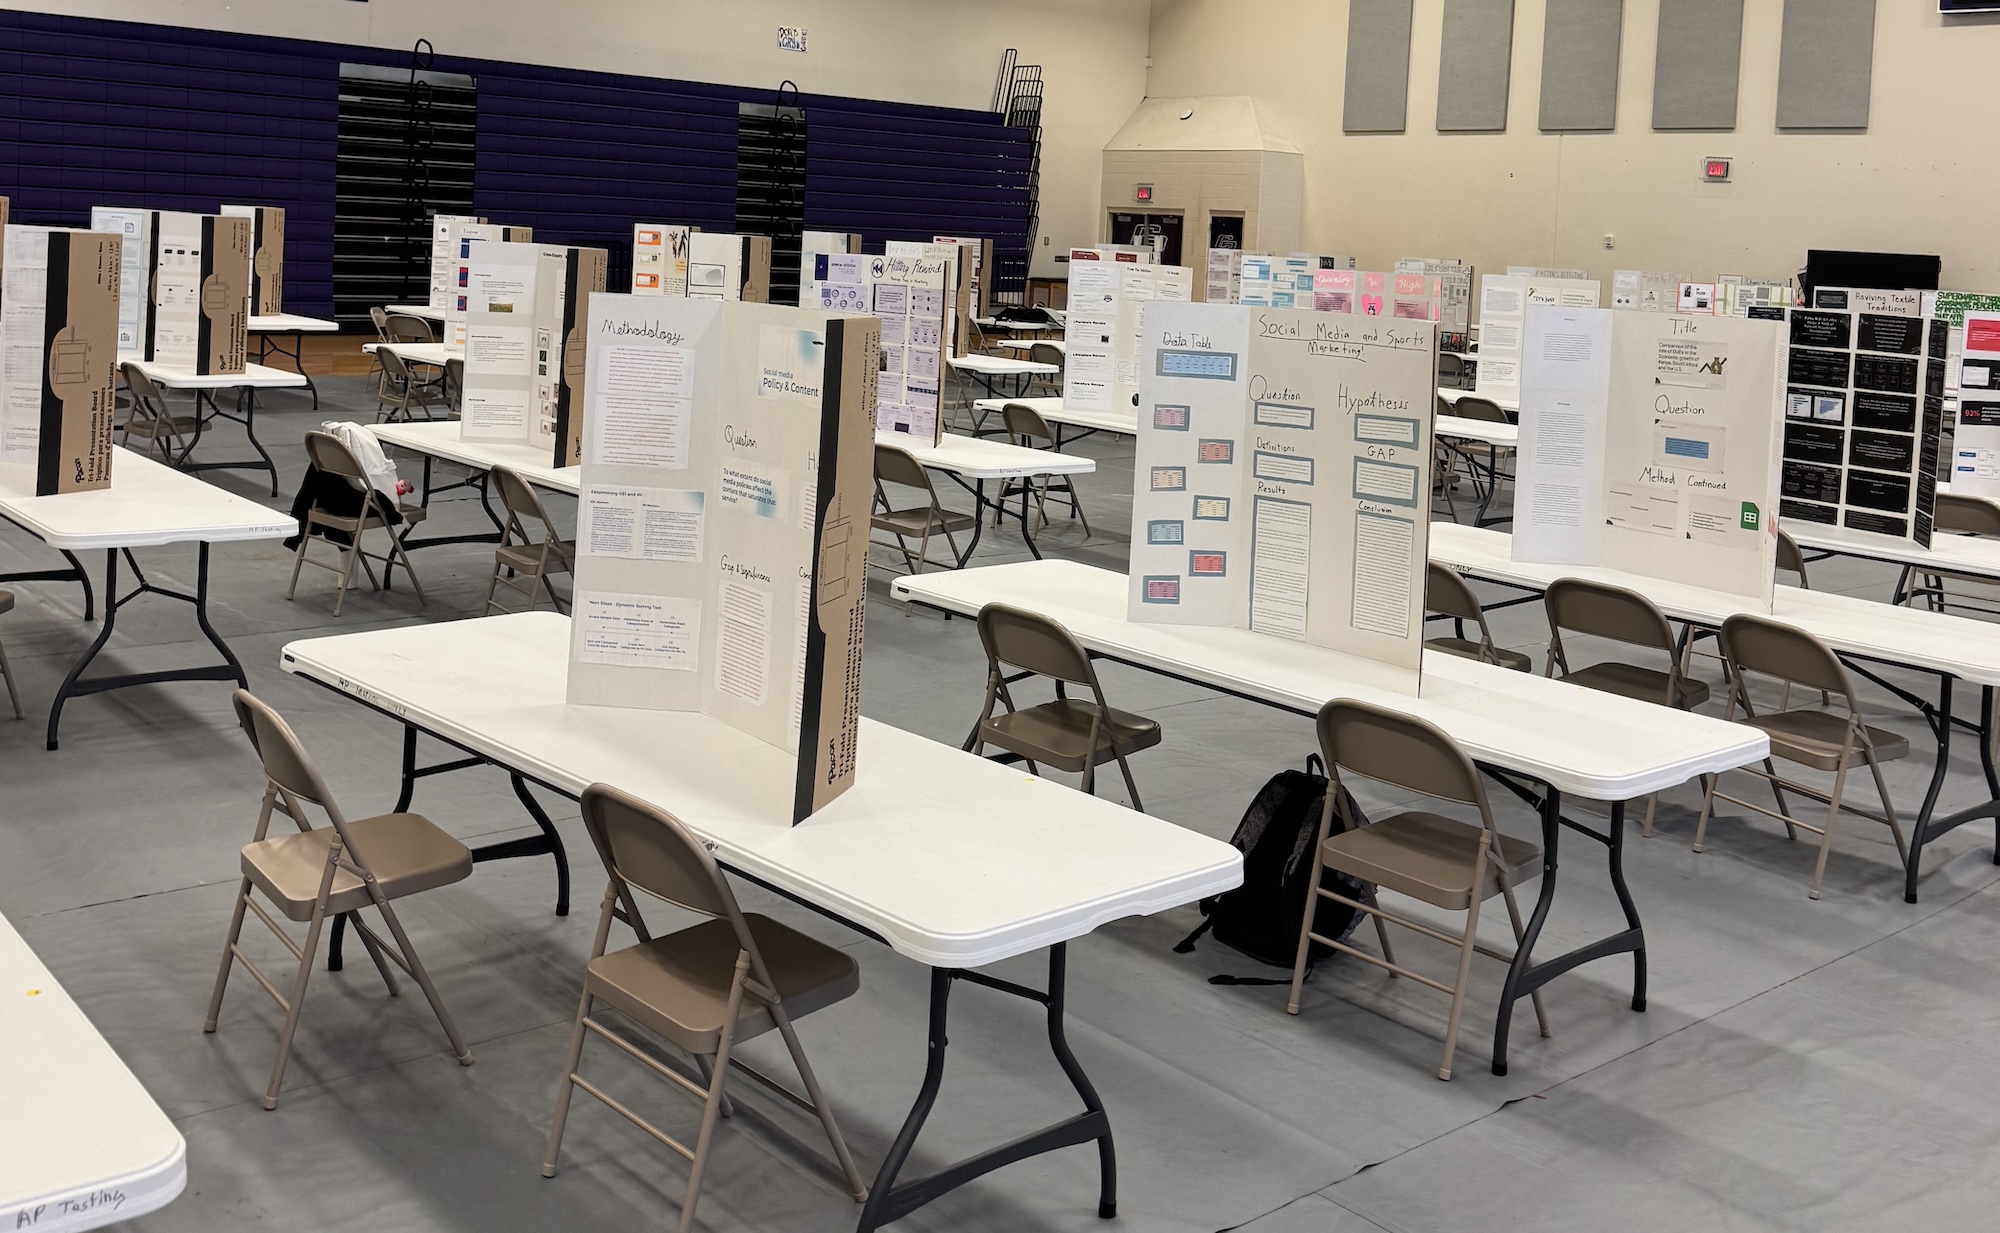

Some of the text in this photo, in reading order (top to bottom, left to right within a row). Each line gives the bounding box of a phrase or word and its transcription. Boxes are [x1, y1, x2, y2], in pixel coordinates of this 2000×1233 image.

[1398, 280, 1420, 292] High
[1868, 303, 1906, 314] Traditions
[1891, 294, 1915, 304] Textile
[601, 319, 685, 346] Methodology
[1259, 314, 1423, 350] Social Media and Sports
[1669, 319, 1697, 335] Title
[1163, 331, 1212, 349] Data Table
[763, 367, 793, 380] Social media
[763, 378, 818, 397] Policy & Content
[1249, 374, 1408, 415] Question Hypothesis
[1655, 394, 1704, 415] Question
[1964, 409, 1980, 417] 93%
[724, 425, 757, 451] Question
[1257, 437, 1395, 460] Definitions GAP
[74, 458, 85, 483] Pacon
[1639, 467, 1726, 489] Method Continued
[736, 481, 751, 490] policies
[722, 495, 738, 503] service?
[1257, 482, 1392, 514] Results Conclusion
[1450, 564, 1472, 573] ONLY
[850, 599, 859, 692] presentaciones
[838, 733, 846, 780] Tri-Fold
[842, 649, 851, 729] Presentation
[828, 738, 836, 785] Pacon
[17, 1189, 126, 1229] AP Testing
